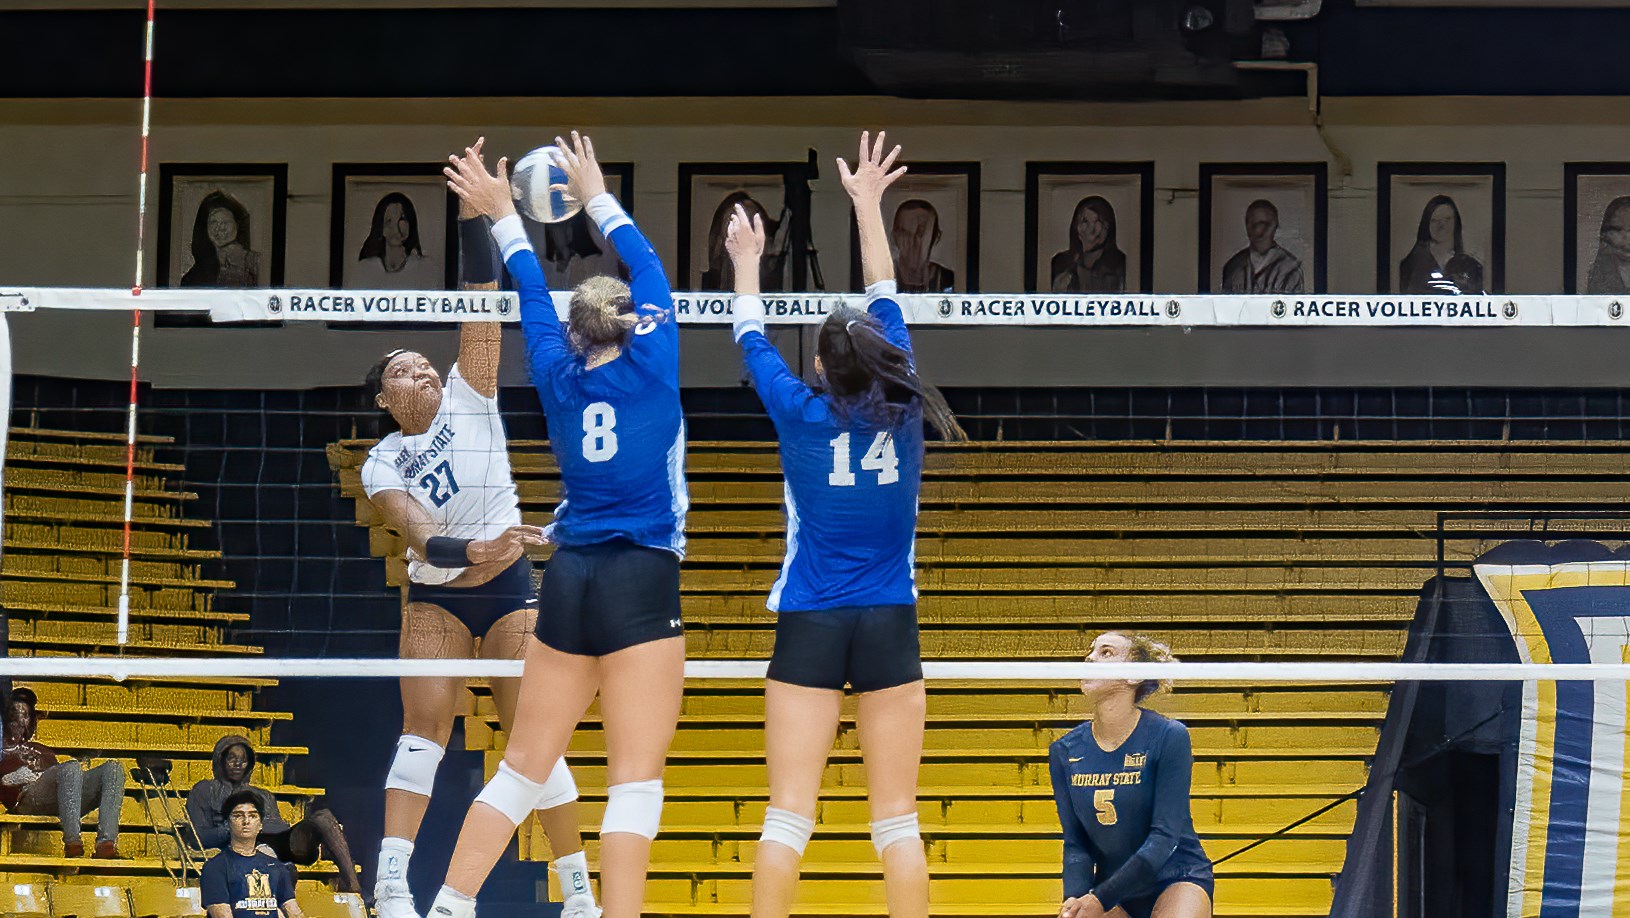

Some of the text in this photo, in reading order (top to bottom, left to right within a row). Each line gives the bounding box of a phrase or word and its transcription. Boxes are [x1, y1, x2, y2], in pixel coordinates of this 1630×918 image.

[290, 296, 492, 314] RACER VOLLEYBALL
[696, 298, 828, 316] VOLYBALL
[961, 299, 1160, 316] RACER VOLLEYBALL
[1293, 300, 1497, 318] RACER VOLLEYBALL
[582, 401, 619, 463] 8
[828, 431, 899, 487] 14
[420, 459, 460, 509] 27
[1071, 770, 1142, 787] MURRAY STATE
[1093, 788, 1118, 826] 5
